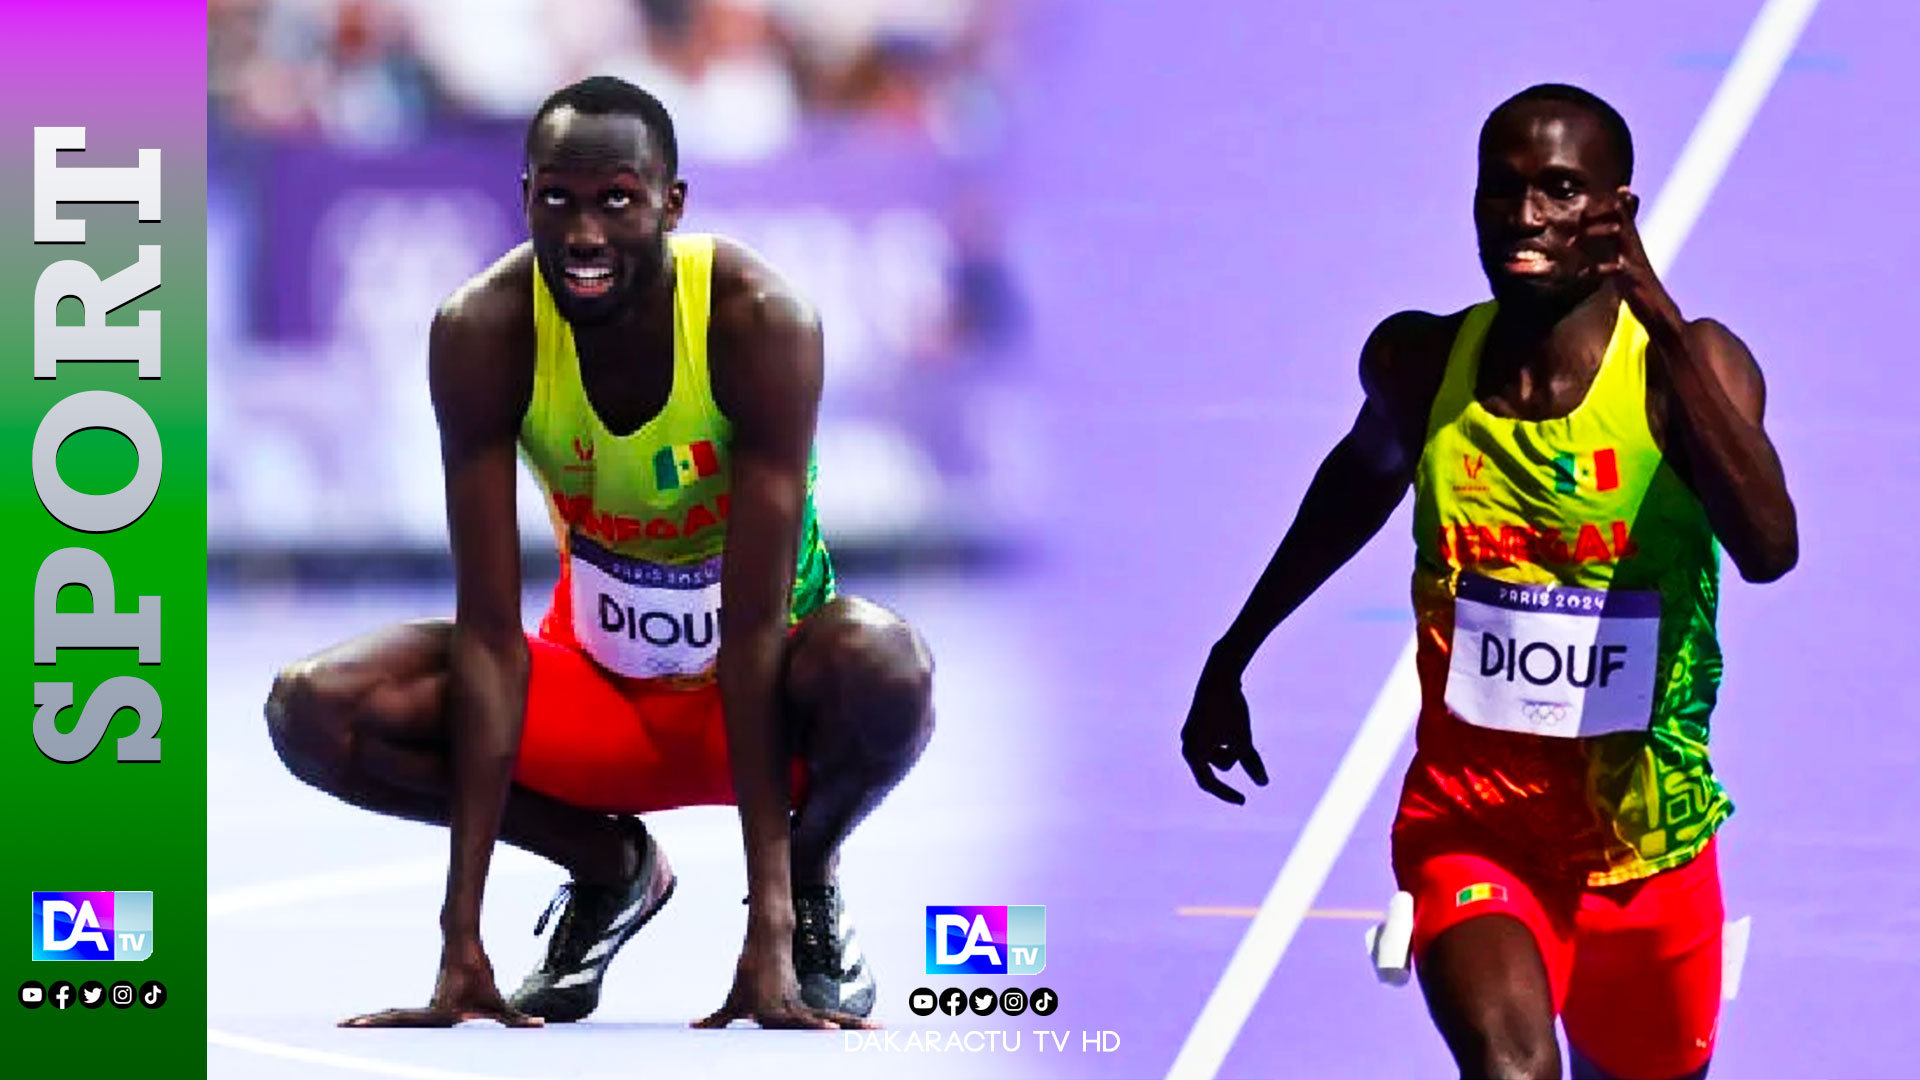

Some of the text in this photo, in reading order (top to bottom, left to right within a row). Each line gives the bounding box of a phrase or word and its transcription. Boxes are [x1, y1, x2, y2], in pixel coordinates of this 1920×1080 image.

[598, 592, 721, 648] DIOU
[1500, 587, 1605, 611] PARIS 2024
[1480, 632, 1628, 688] DIOUF
